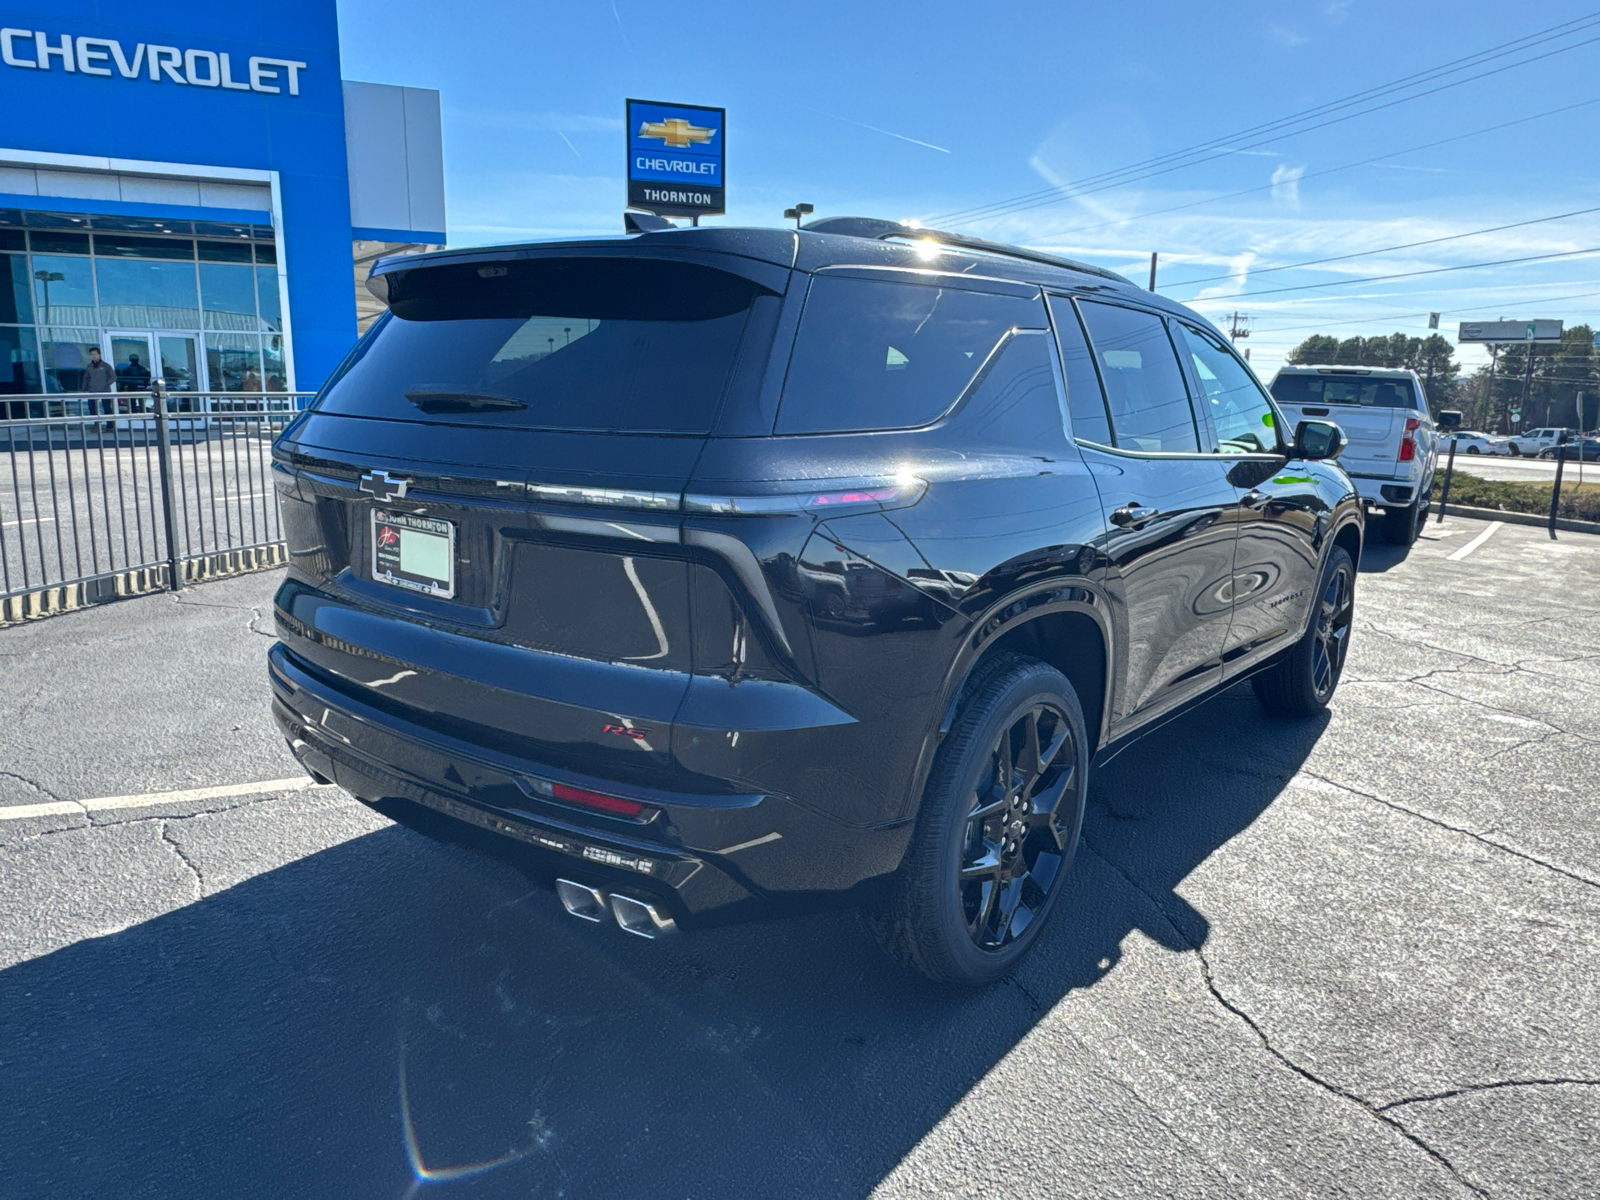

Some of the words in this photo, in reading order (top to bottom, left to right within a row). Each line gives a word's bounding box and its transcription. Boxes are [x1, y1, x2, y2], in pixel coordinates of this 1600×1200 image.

[0, 27, 307, 96] CHEVROLET
[636, 157, 716, 175] CHEVROLET
[643, 188, 711, 204] THORNTON
[408, 517, 448, 533] THORNTON
[602, 724, 646, 740] RS
